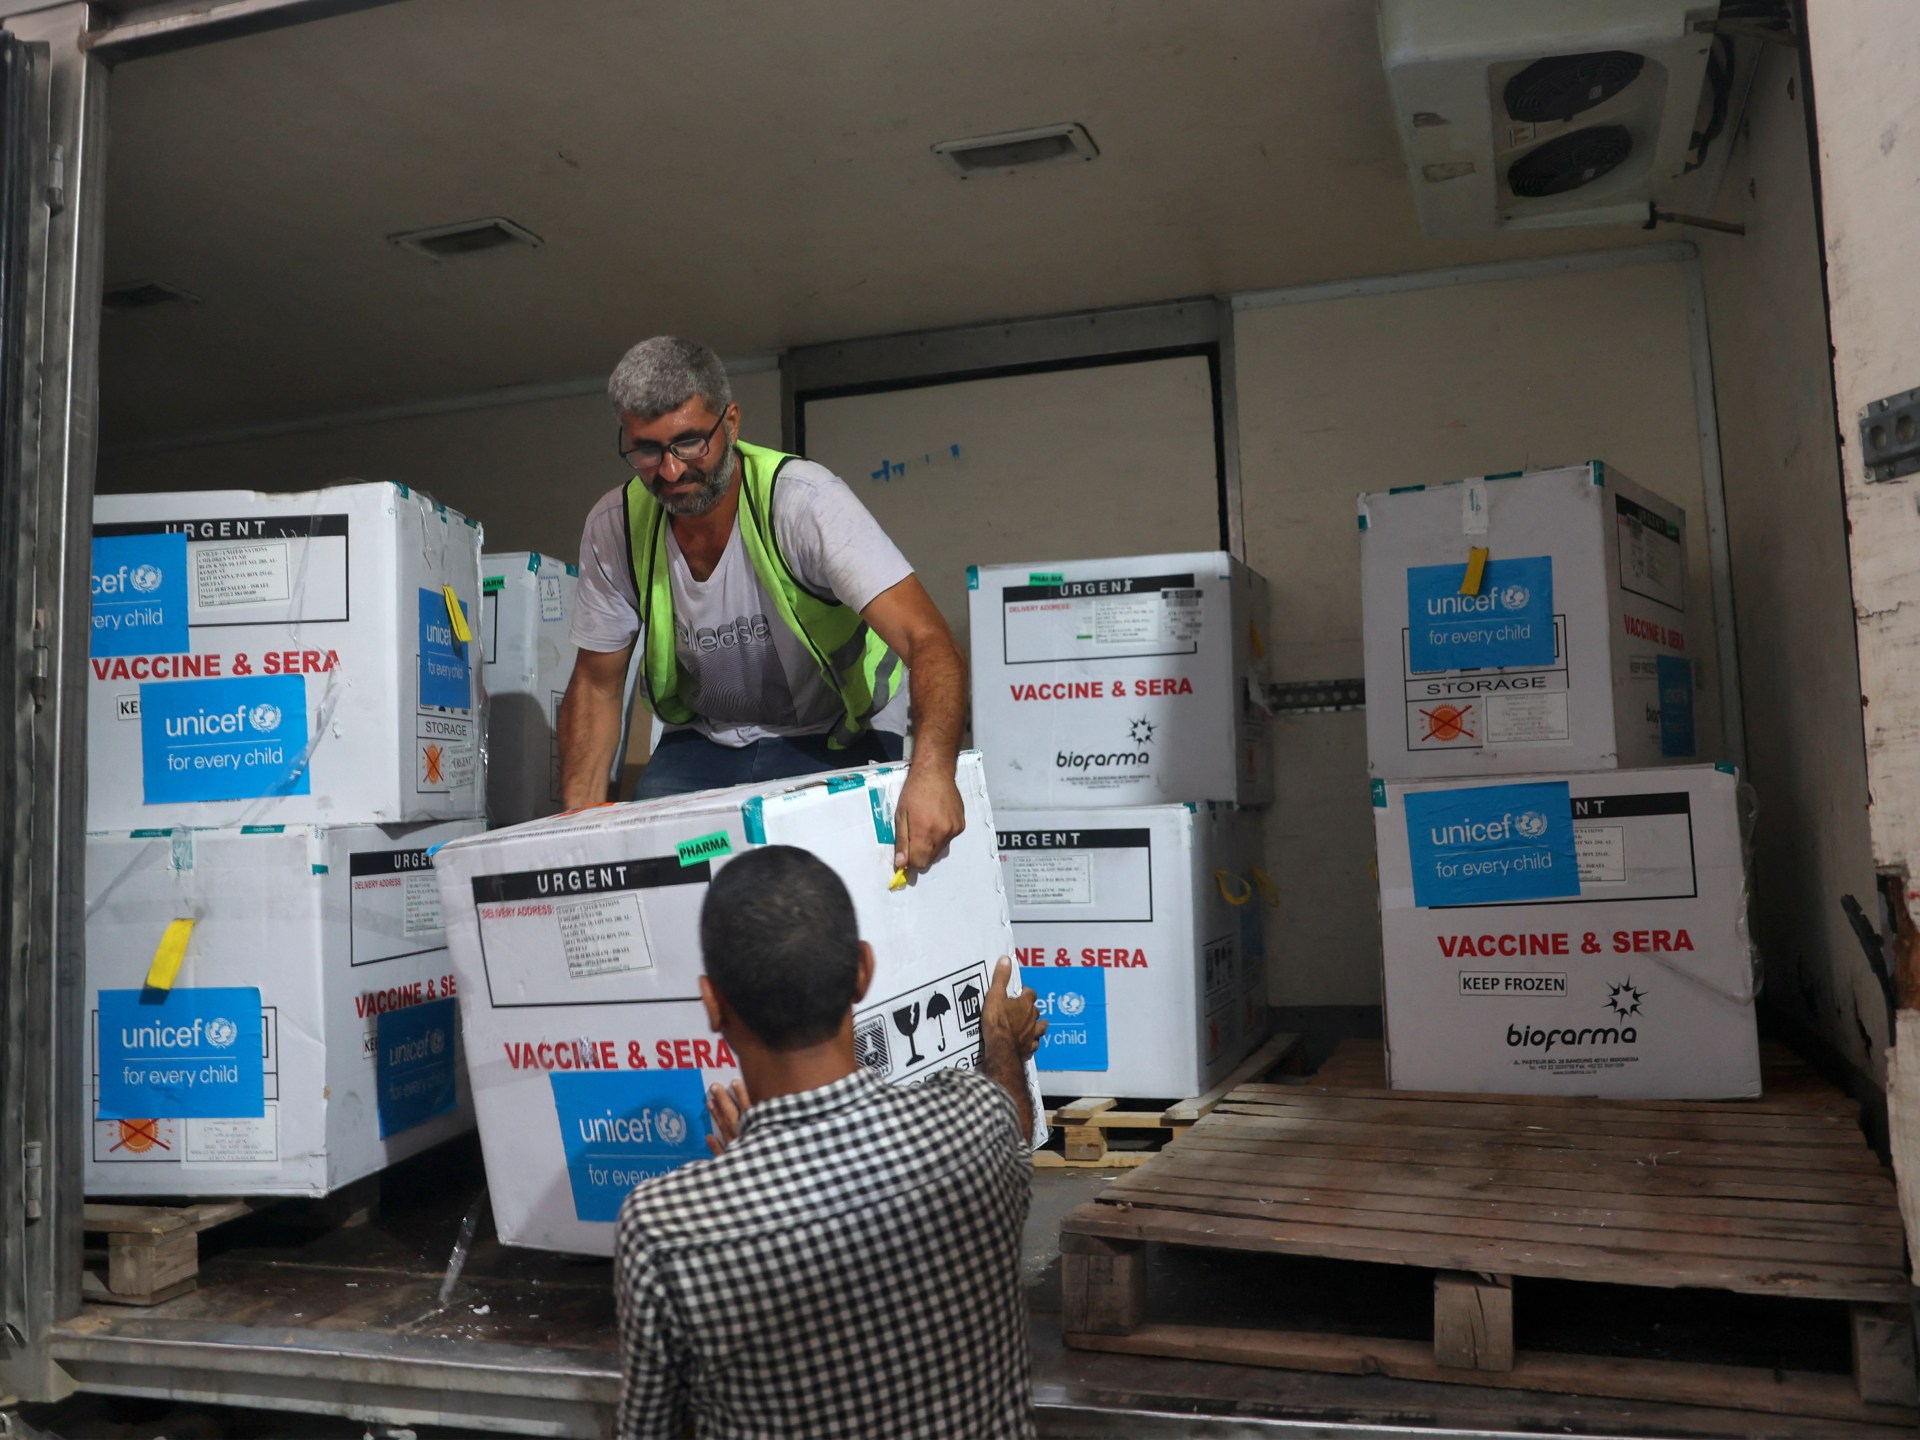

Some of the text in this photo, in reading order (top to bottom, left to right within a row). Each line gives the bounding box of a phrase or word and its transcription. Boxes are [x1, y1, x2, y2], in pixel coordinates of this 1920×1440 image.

[164, 520, 267, 538] URGENT
[92, 566, 127, 594] cef
[1060, 579, 1134, 596] URGENT
[1428, 587, 1498, 616] unicef
[94, 608, 163, 630] ery child
[1624, 614, 1660, 644] VACCINE
[426, 620, 452, 646] unice
[1429, 624, 1530, 646] for every child
[92, 649, 342, 681] VACCINE & SERA
[428, 658, 436, 676] for
[436, 663, 451, 680] every
[1010, 678, 1194, 701] VACCINE & SERA
[1426, 676, 1547, 695] STORAGE
[120, 700, 140, 714] KE
[165, 704, 247, 736] unicef
[425, 720, 468, 736] STORAGE
[167, 746, 283, 772] for every child
[1056, 750, 1149, 772] biofarma
[997, 832, 1081, 848] URGENT
[1432, 814, 1512, 846] unicef
[678, 836, 730, 860] PHARMA
[1436, 852, 1552, 878] for every child
[537, 866, 628, 893] URGENT
[482, 906, 514, 920] DELIVERY
[1438, 930, 1694, 958] VACCINE & SERA
[1054, 948, 1072, 967] &
[1081, 948, 1148, 968] SERA
[355, 974, 456, 1019] VACCINE & SE
[1463, 978, 1565, 992] KEEP FROZEN
[964, 996, 978, 1016] UP
[122, 1018, 202, 1048] unicef
[1054, 1030, 1087, 1045] child
[1507, 1024, 1637, 1053] biofarma
[390, 1029, 430, 1066] unicef
[627, 1041, 645, 1069] &
[656, 1038, 736, 1069] SERA
[123, 1064, 238, 1087] for every child
[578, 1108, 654, 1143] unicef
[588, 1164, 608, 1186] for
